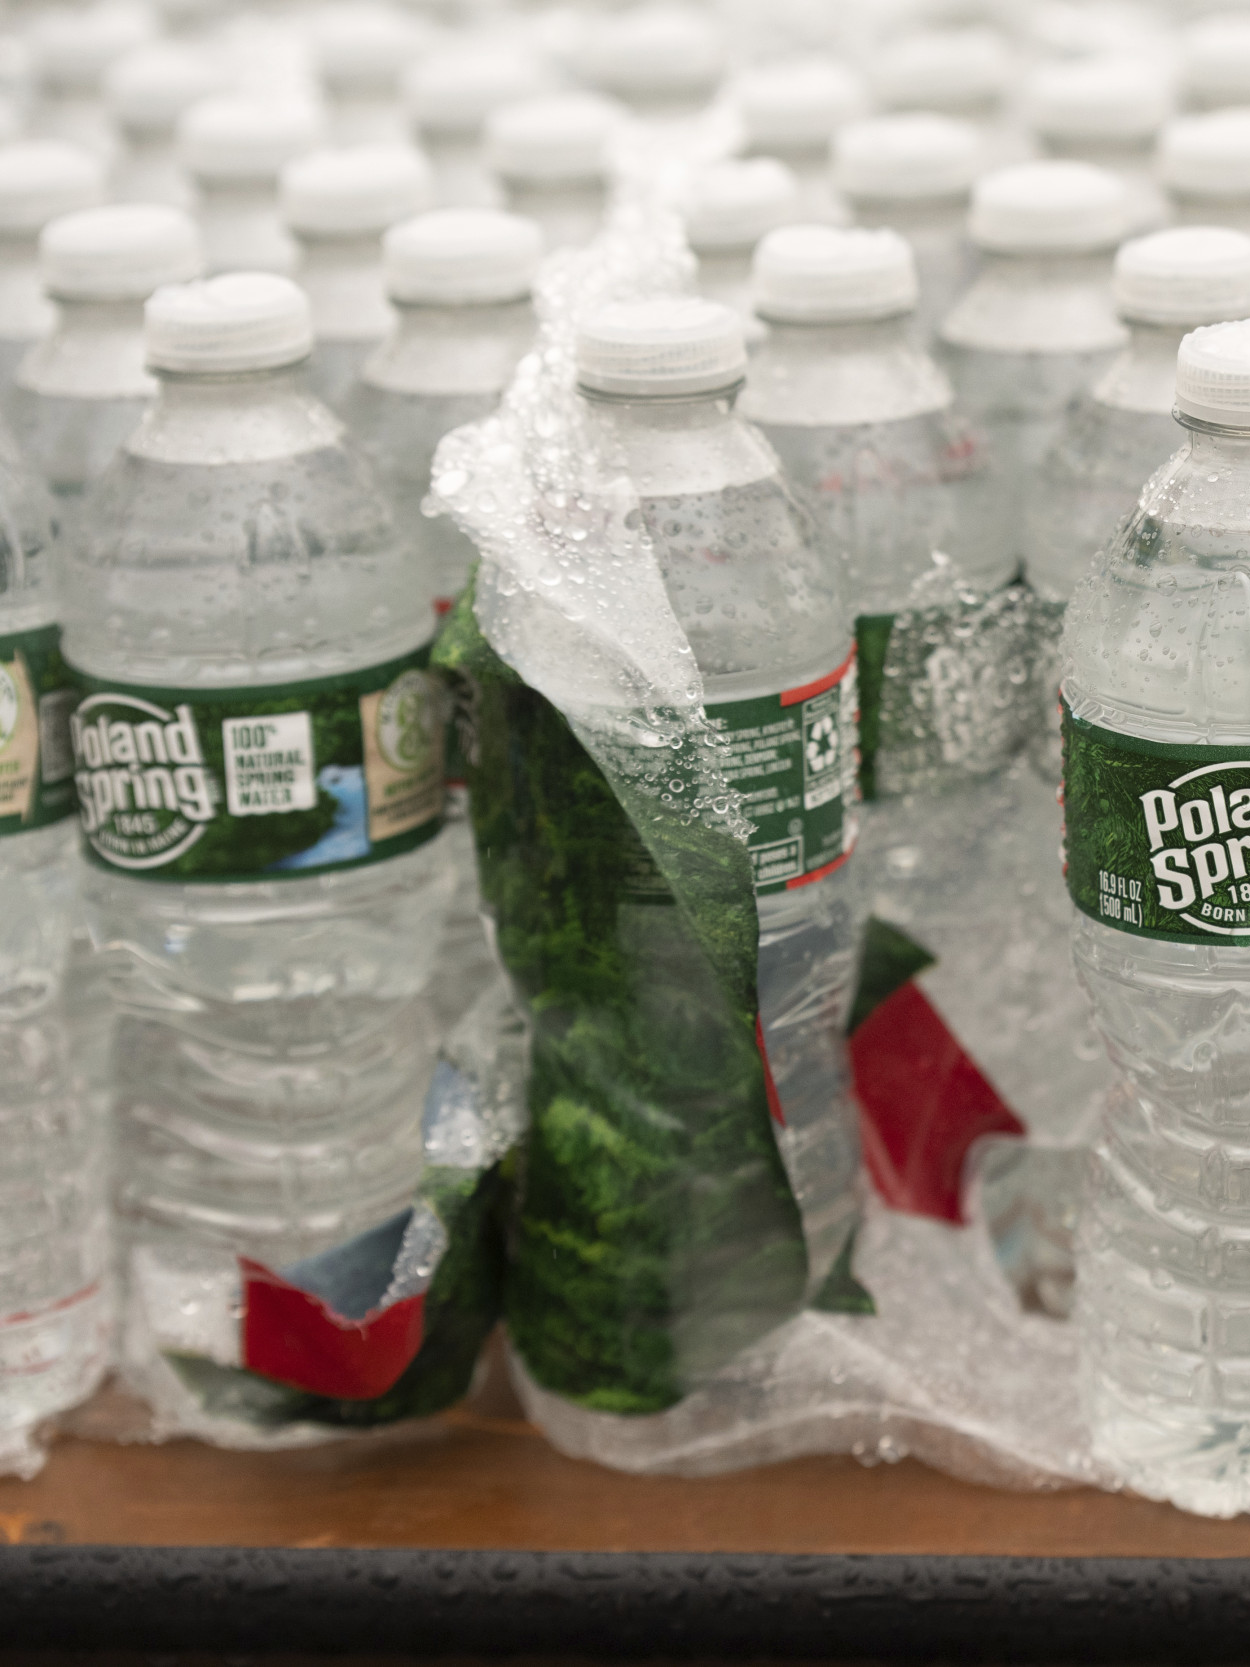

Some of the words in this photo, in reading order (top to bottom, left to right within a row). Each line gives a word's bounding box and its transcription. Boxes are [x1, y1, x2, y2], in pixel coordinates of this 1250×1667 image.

[1099, 869, 1117, 895] 16.9
[1117, 876, 1128, 898] FL
[1129, 879, 1142, 902] OZ
[1099, 892, 1121, 919] (500
[1123, 903, 1143, 928] mL)
[1201, 902, 1246, 922] BORN
